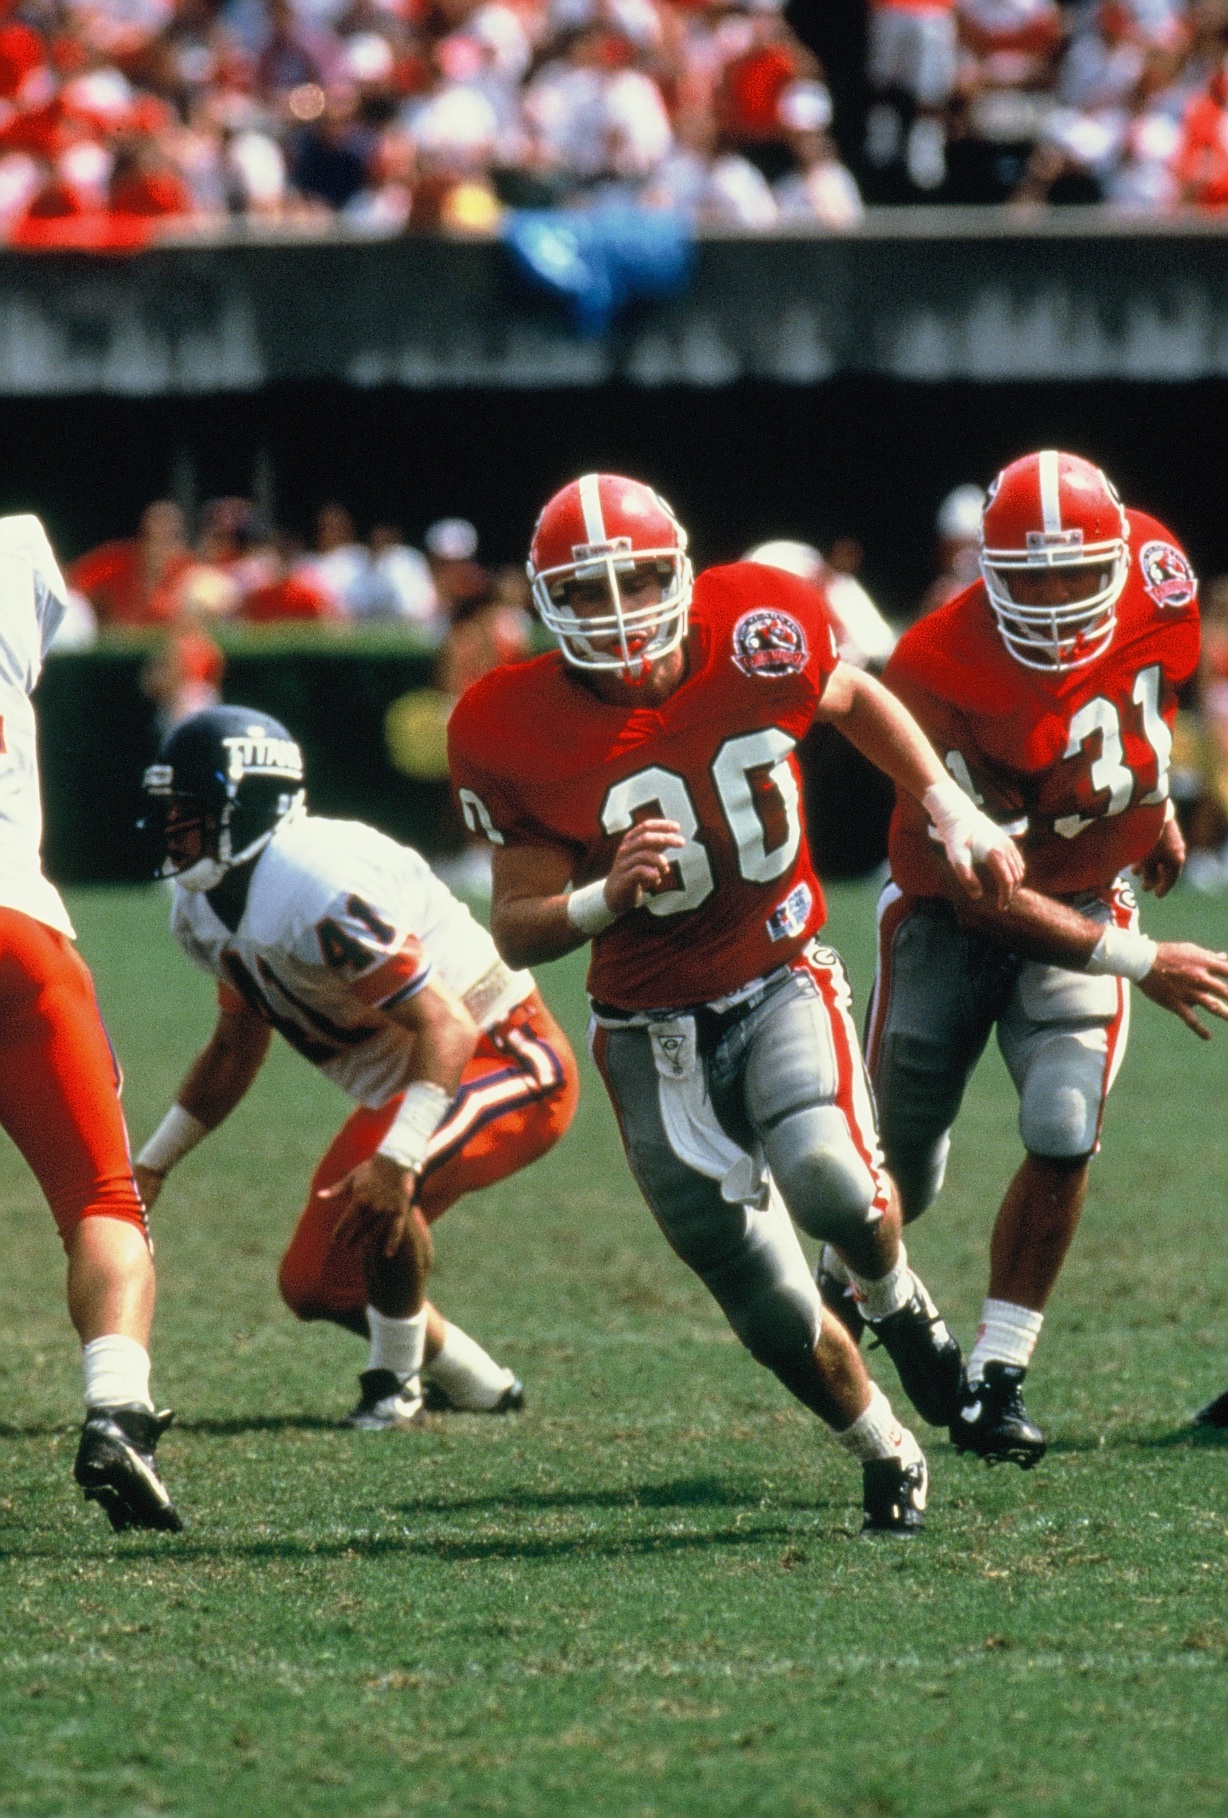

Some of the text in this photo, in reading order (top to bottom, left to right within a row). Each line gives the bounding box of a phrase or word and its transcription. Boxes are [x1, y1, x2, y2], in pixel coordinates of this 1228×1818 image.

[1054, 664, 1172, 838] 31
[602, 728, 801, 917] 30
[315, 893, 396, 970] 41
[812, 949, 837, 966] G
